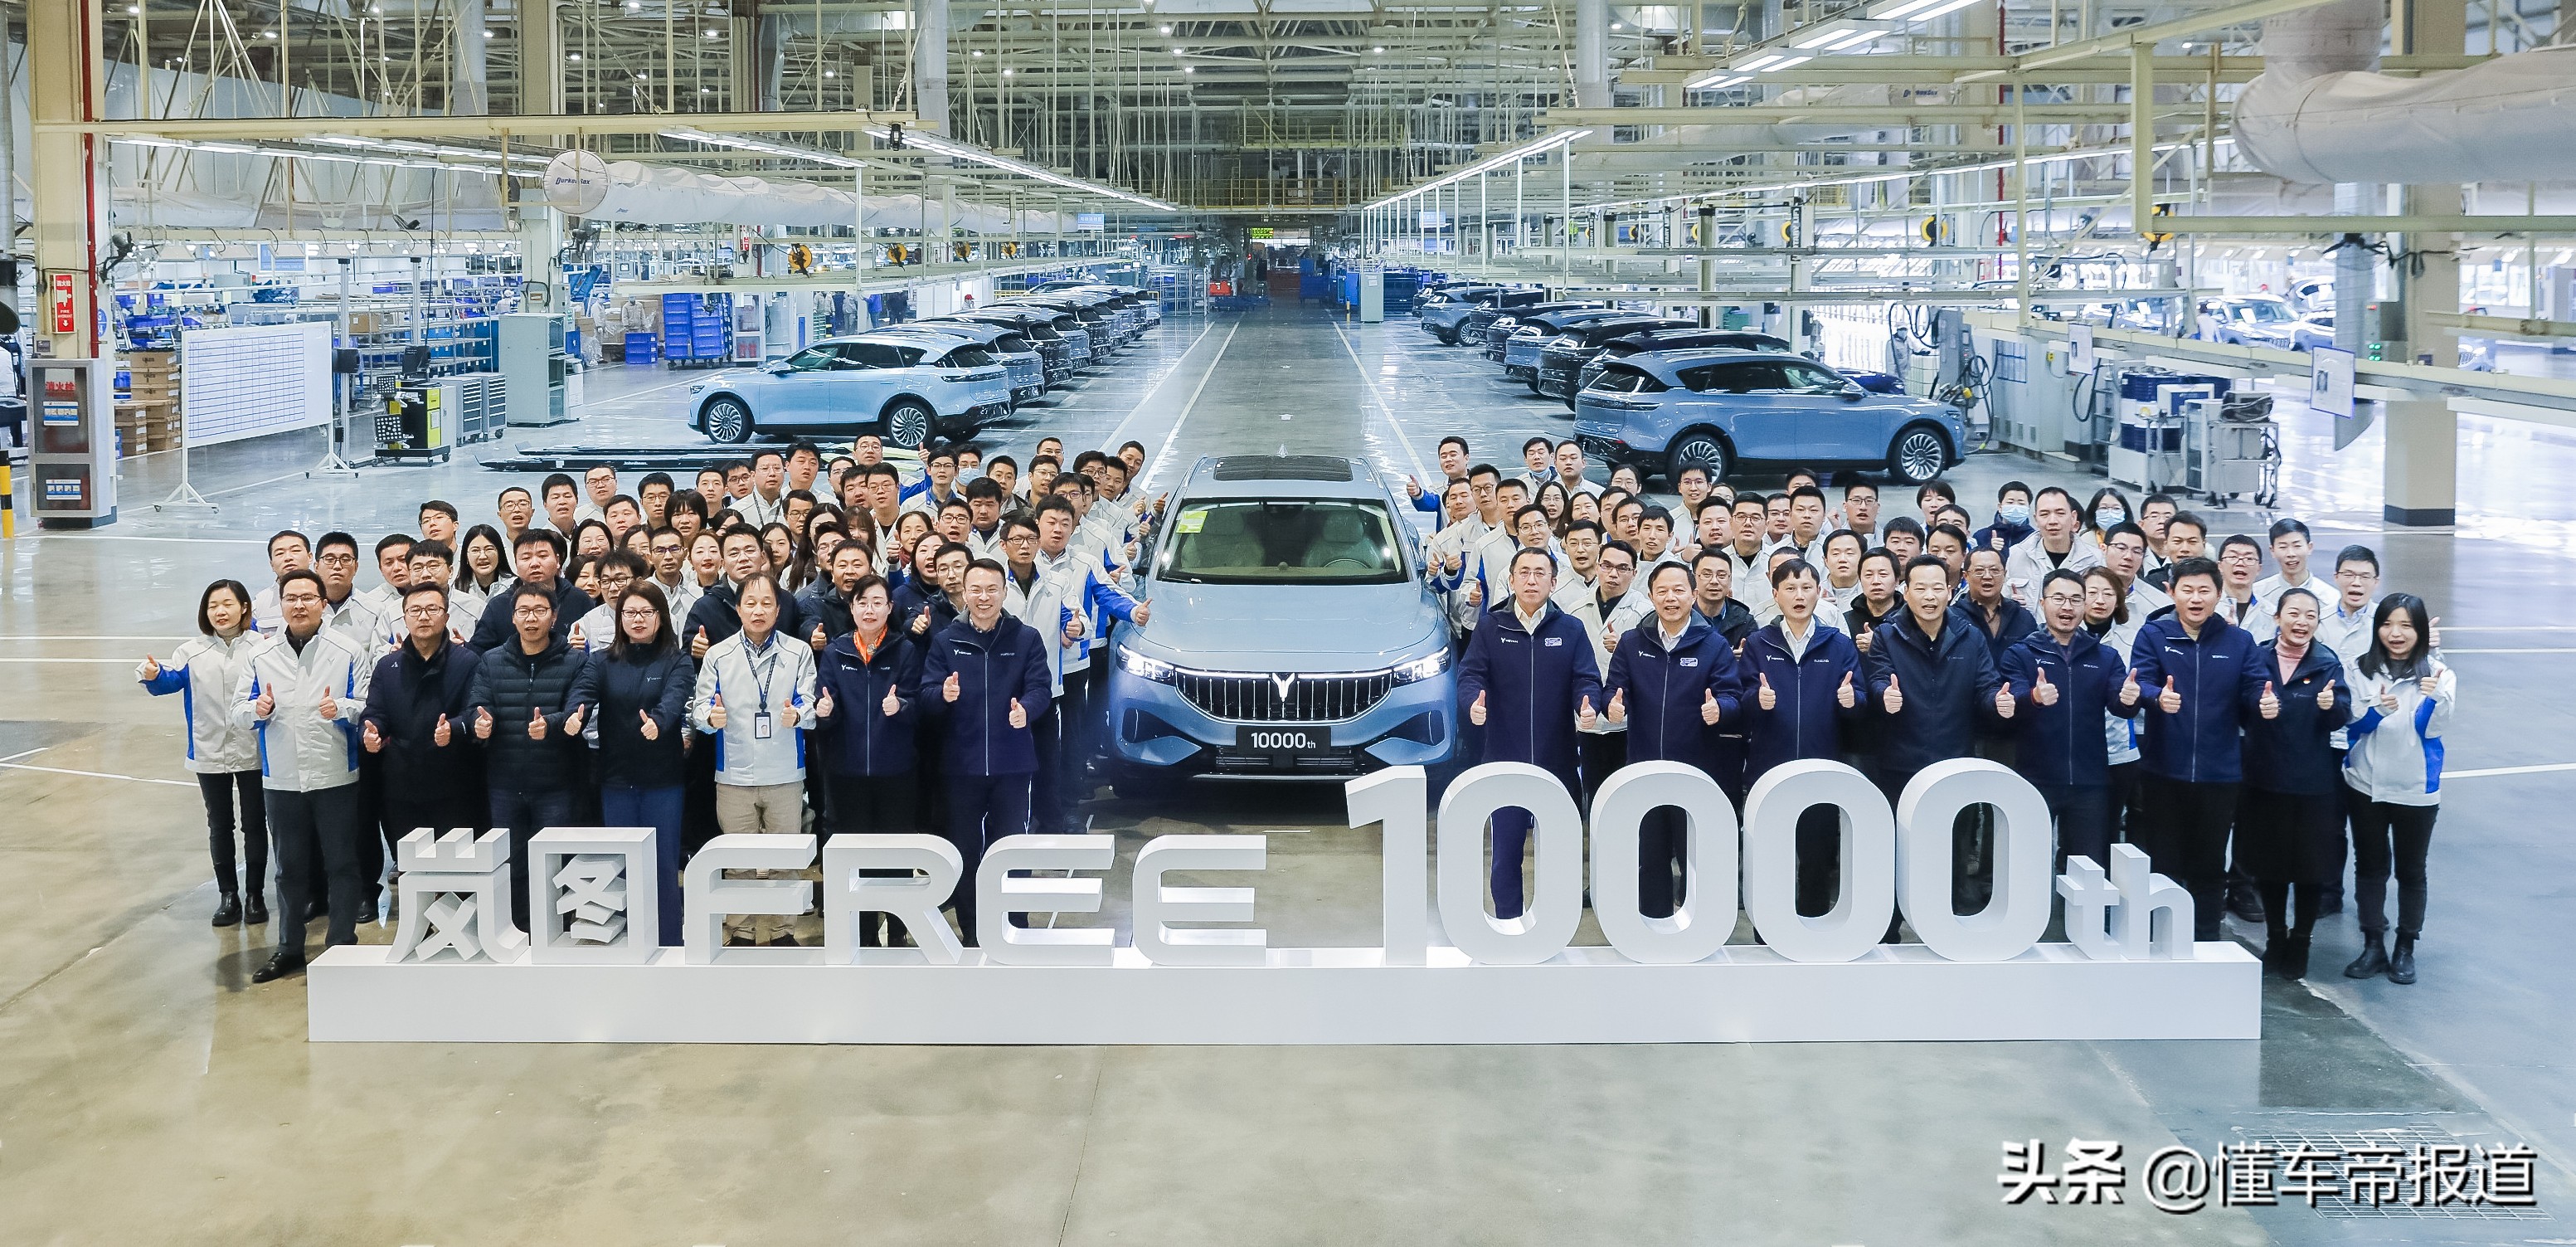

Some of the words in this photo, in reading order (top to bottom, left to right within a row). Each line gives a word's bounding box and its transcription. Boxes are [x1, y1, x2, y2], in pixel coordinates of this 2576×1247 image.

[46, 381, 75, 392] 消火栓
[385, 827, 659, 965] 岚图
[685, 833, 1267, 966] FREE
